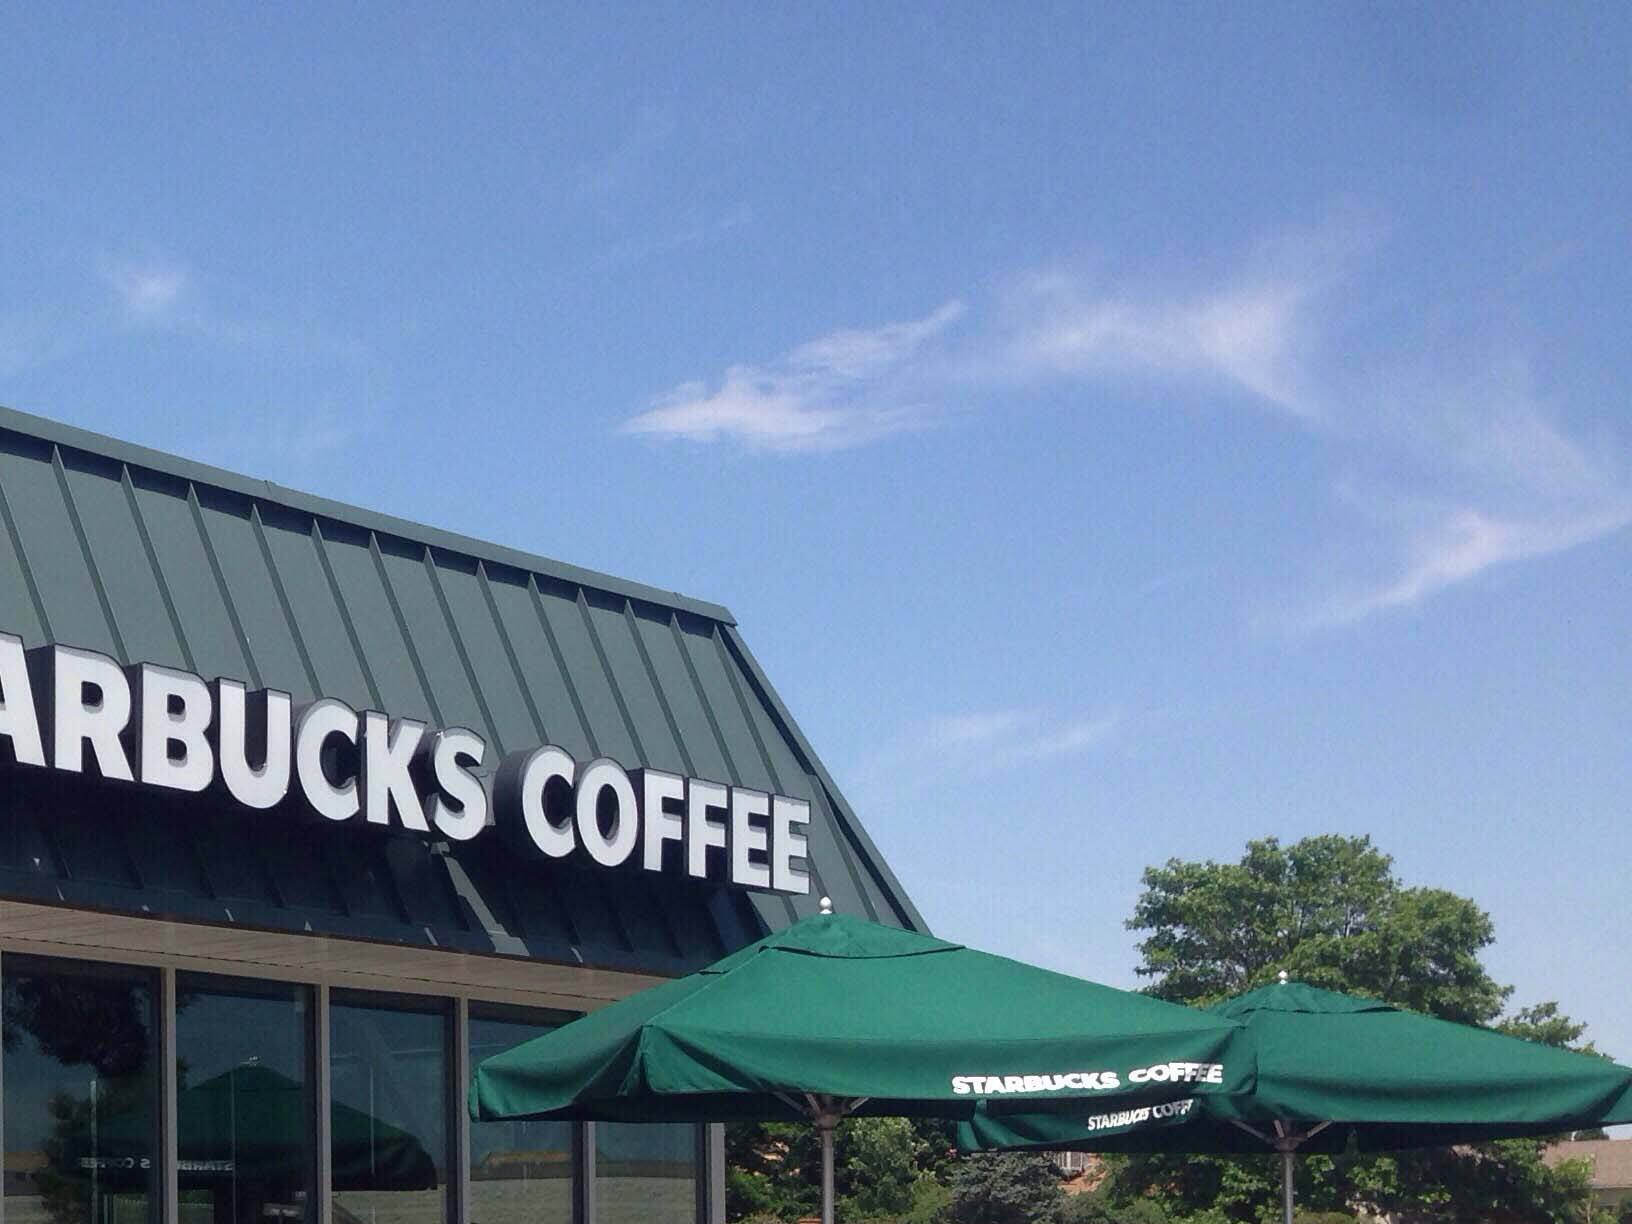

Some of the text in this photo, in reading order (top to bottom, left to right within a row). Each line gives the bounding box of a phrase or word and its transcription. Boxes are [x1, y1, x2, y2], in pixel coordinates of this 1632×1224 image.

[522, 744, 811, 894] COFFEE
[951, 1062, 1223, 1094] STARBUCKS COFFEE
